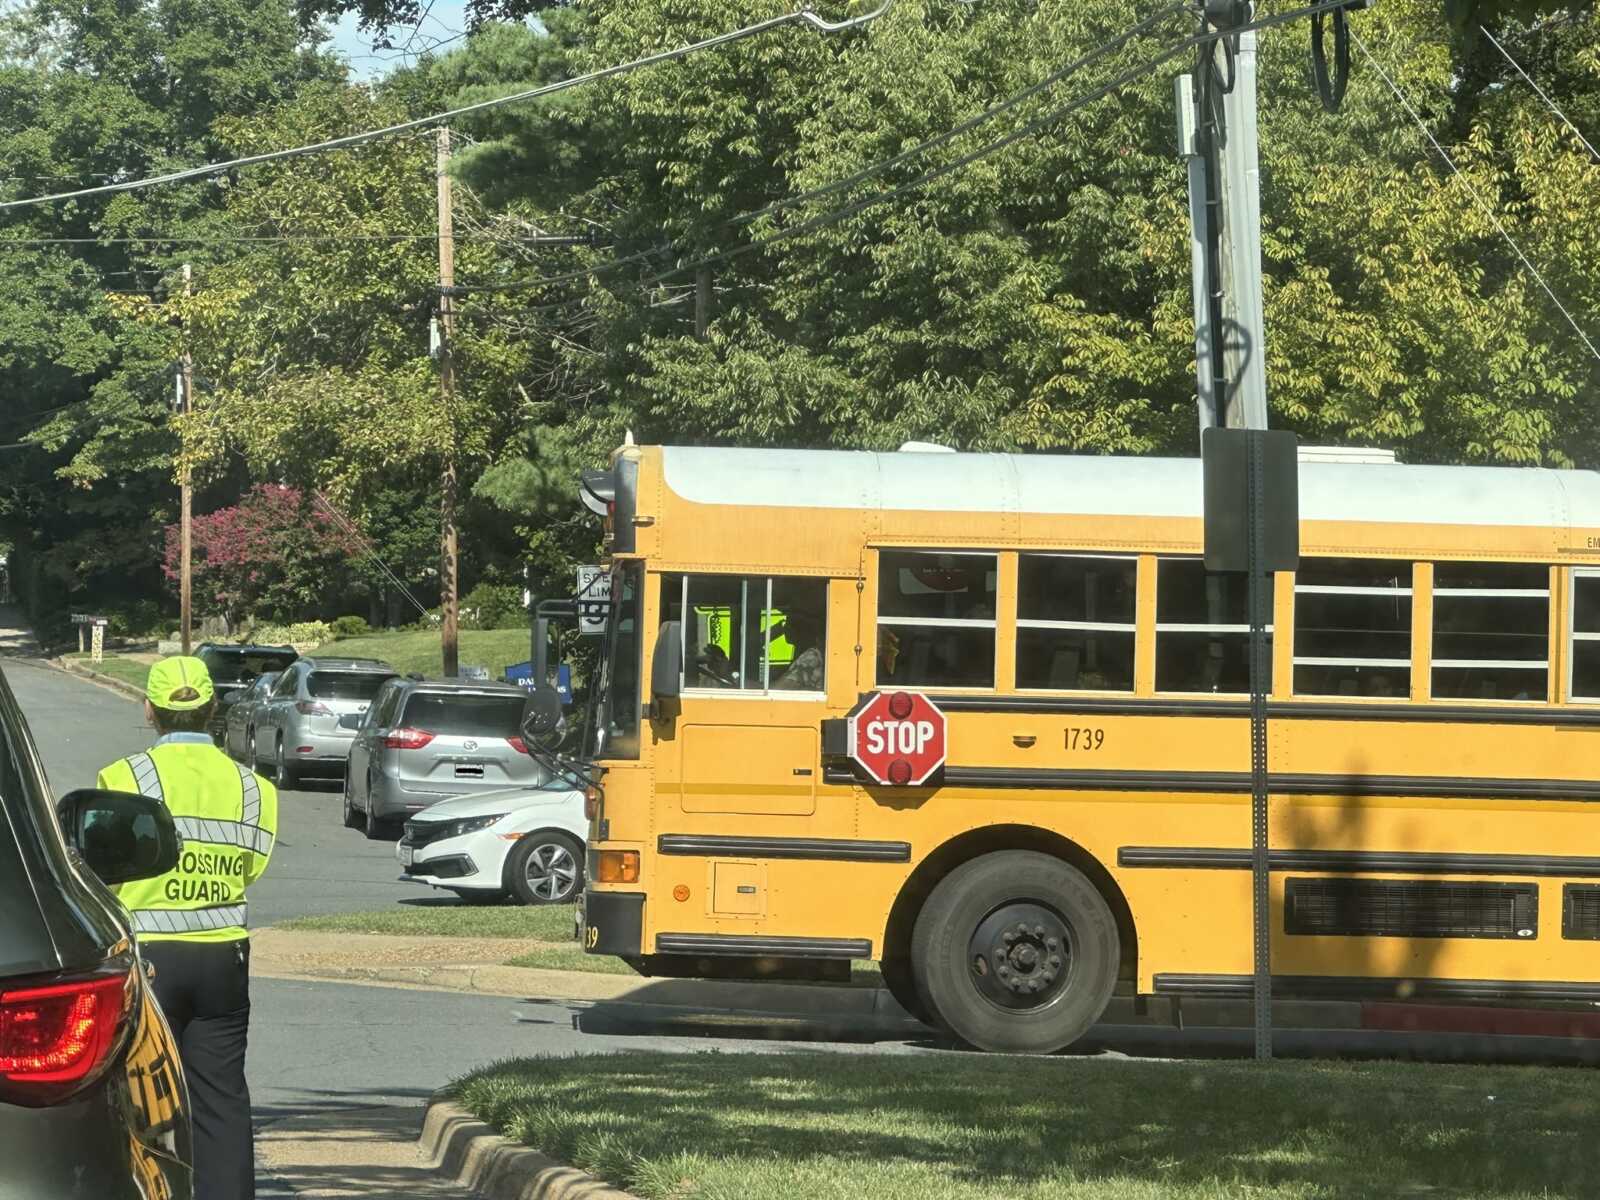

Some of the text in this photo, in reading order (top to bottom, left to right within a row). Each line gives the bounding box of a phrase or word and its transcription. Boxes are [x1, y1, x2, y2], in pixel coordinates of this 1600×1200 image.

[583, 573, 610, 584] SPE
[588, 586, 610, 597] LIM
[866, 720, 935, 755] STOP
[1063, 727, 1105, 751] 1739
[175, 851, 243, 877] OSSING
[164, 878, 231, 903] GUARD
